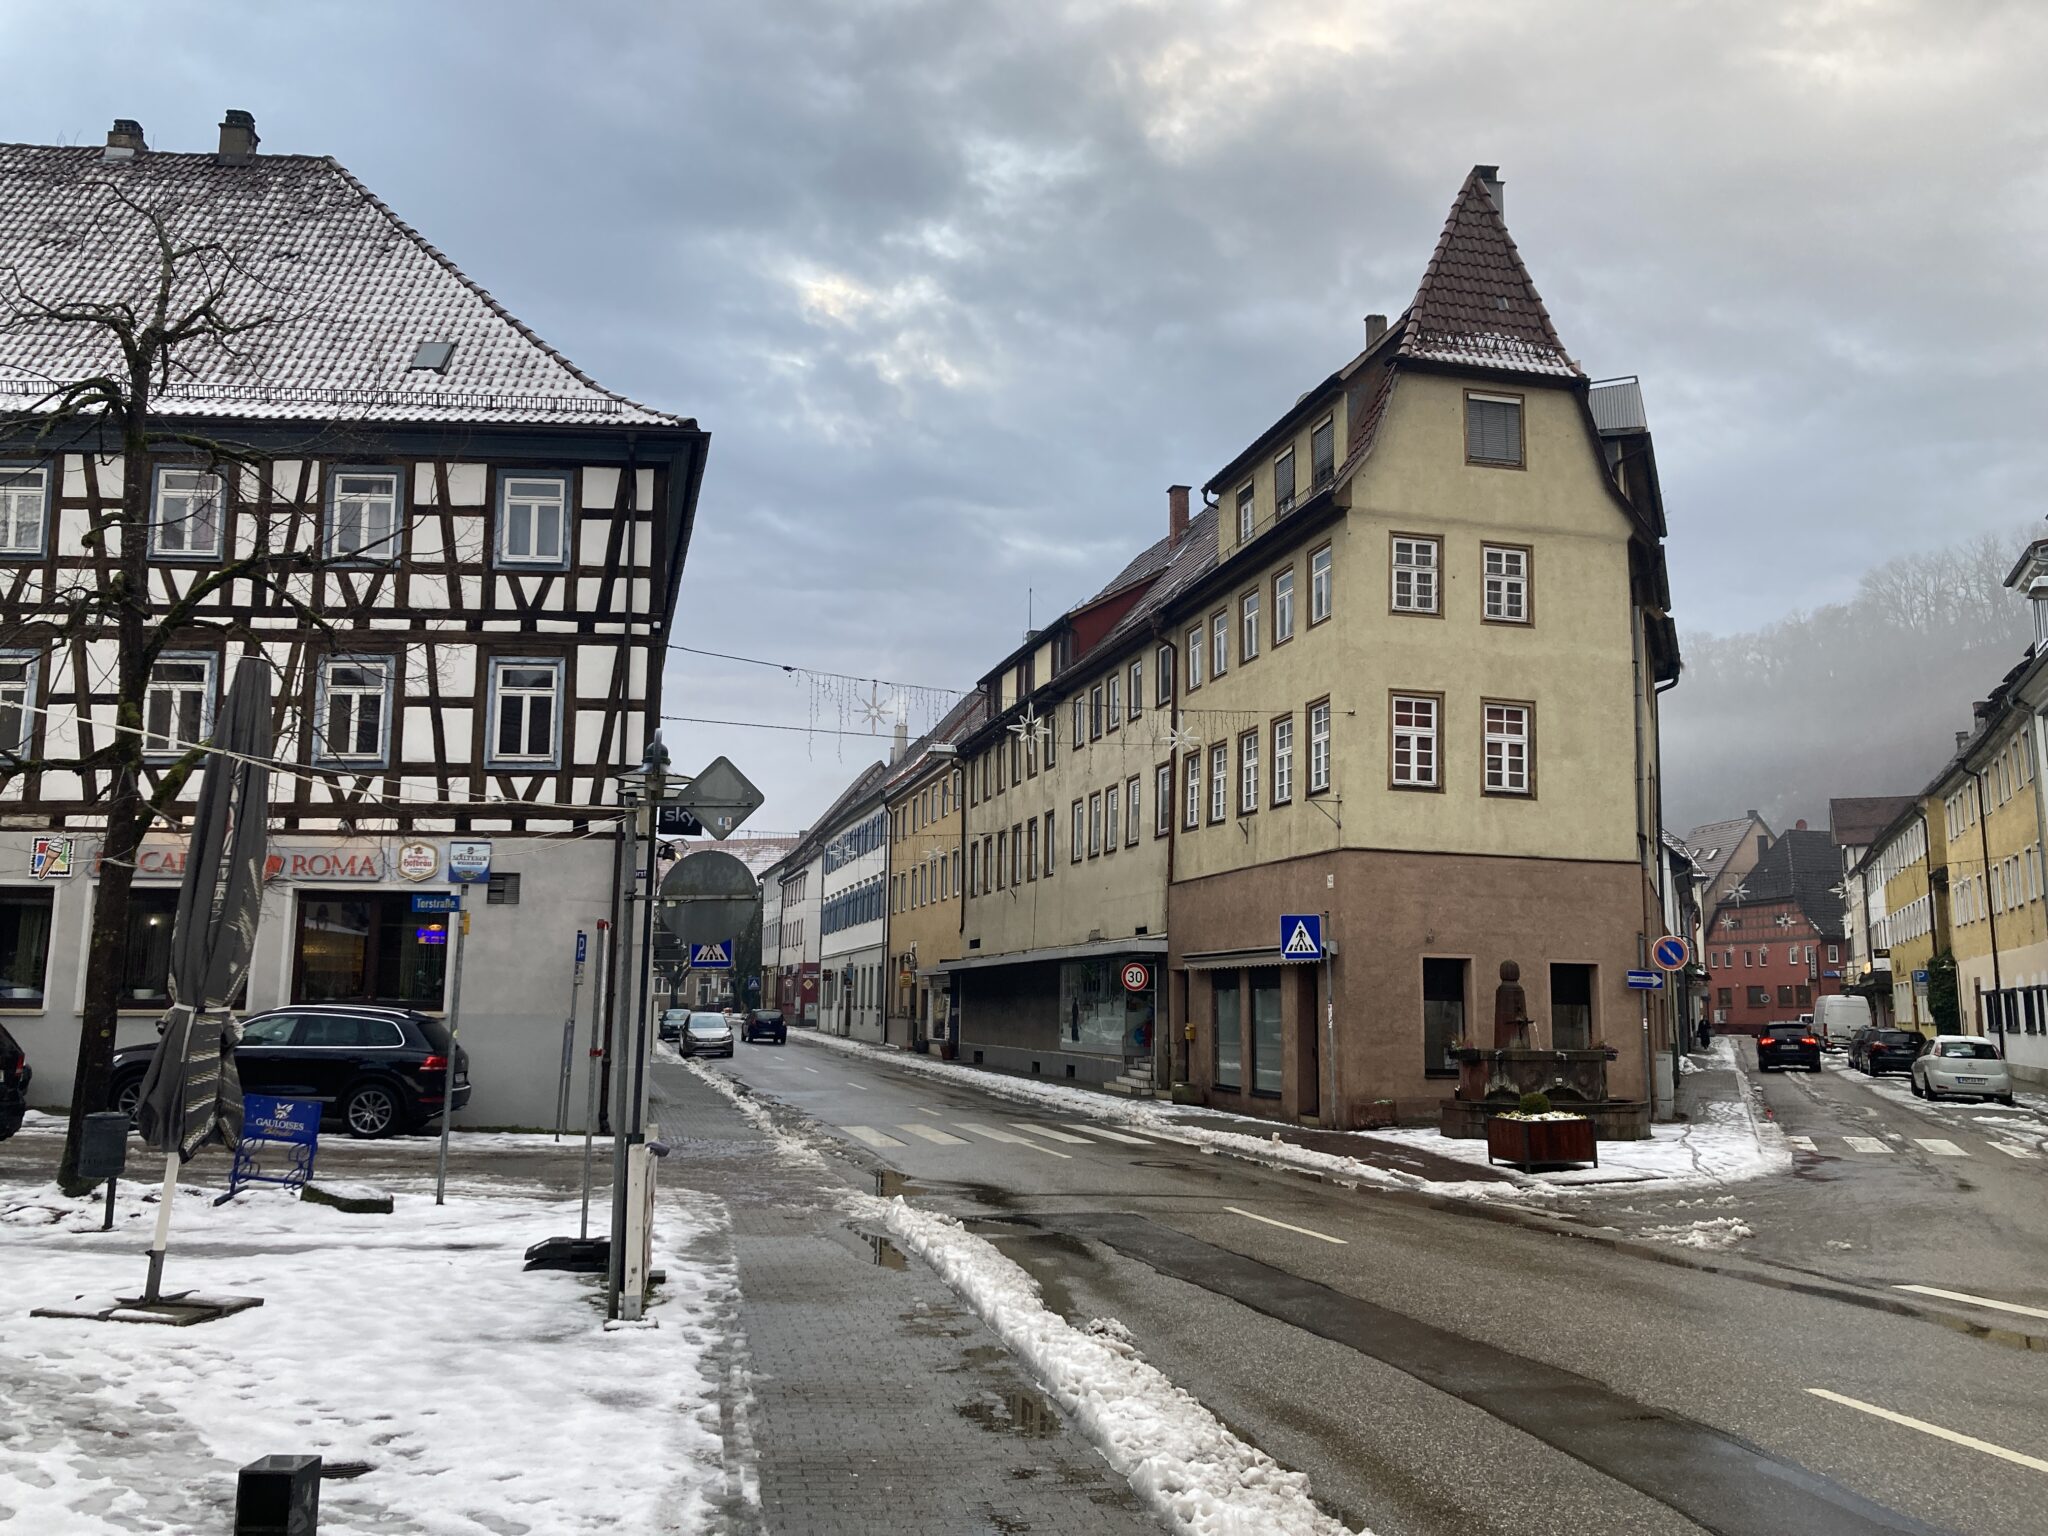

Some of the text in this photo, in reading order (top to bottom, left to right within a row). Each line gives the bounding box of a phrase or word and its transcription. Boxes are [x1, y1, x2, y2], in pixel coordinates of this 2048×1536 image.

[664, 806, 695, 827] sky
[291, 854, 377, 876] ROMA
[416, 898, 458, 909] Torstraße
[1127, 970, 1143, 983] 30
[255, 1117, 305, 1131] GAULOISES
